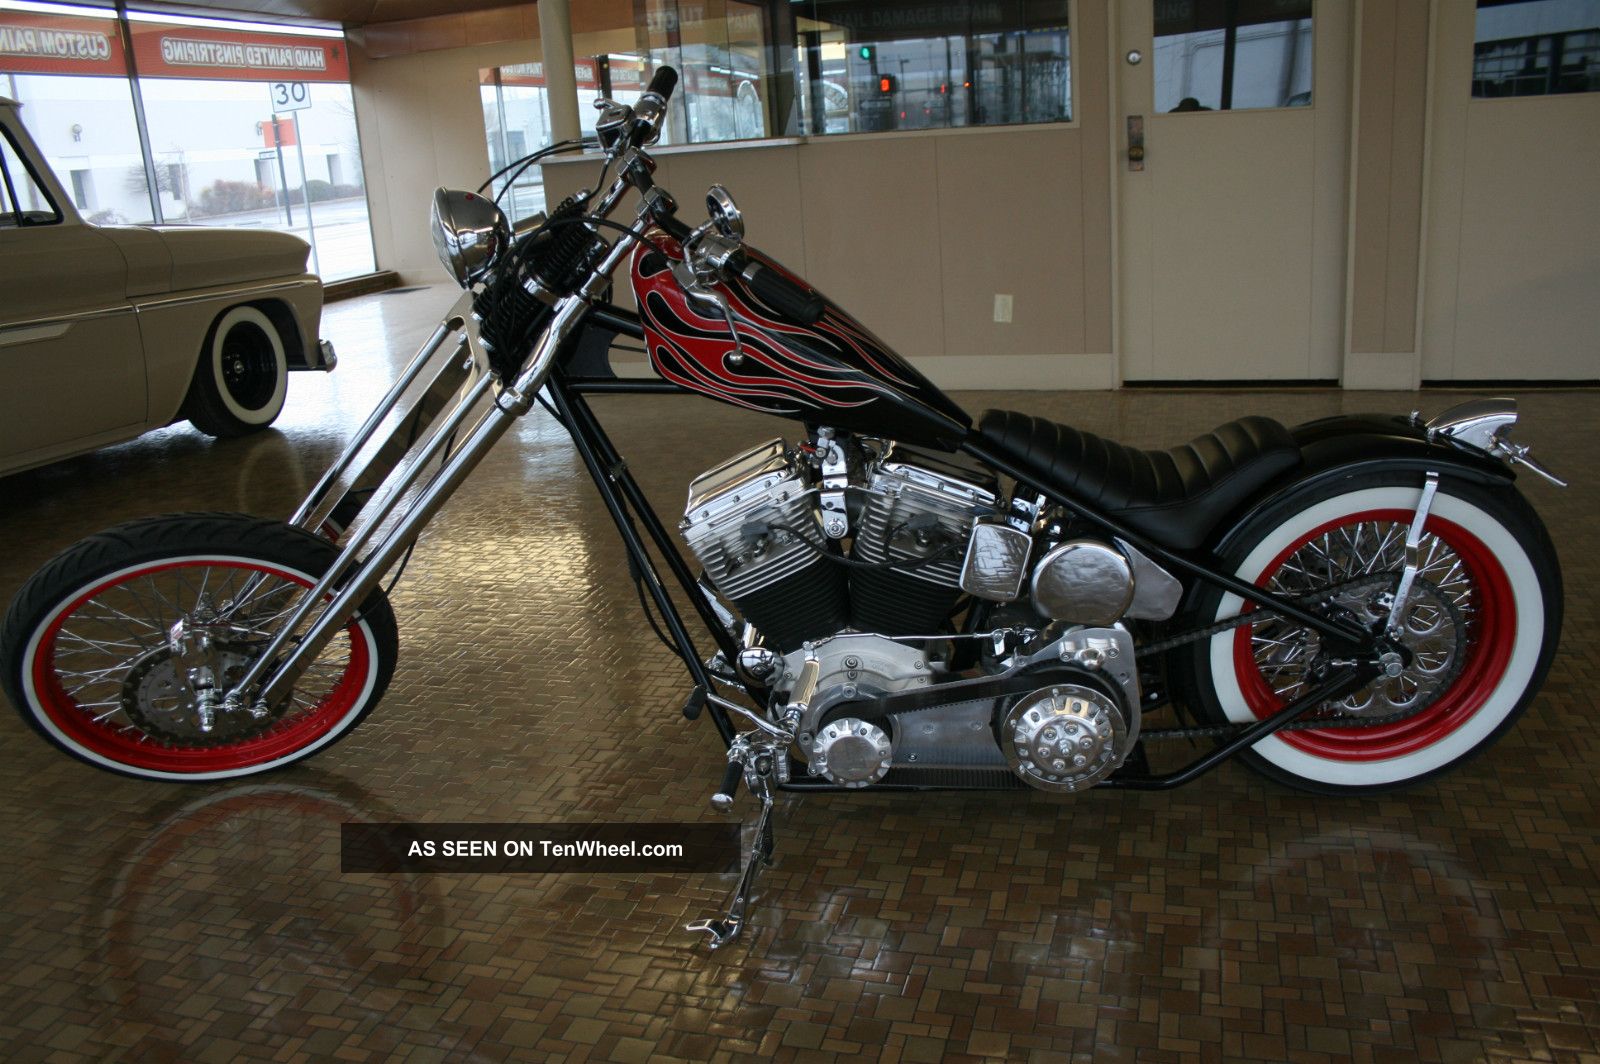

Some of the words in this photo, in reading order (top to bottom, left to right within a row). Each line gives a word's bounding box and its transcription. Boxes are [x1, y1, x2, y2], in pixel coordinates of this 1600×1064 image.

[873, 7, 937, 26] DAMAGE
[942, 3, 1001, 22] REPAIR
[275, 82, 306, 105] 30
